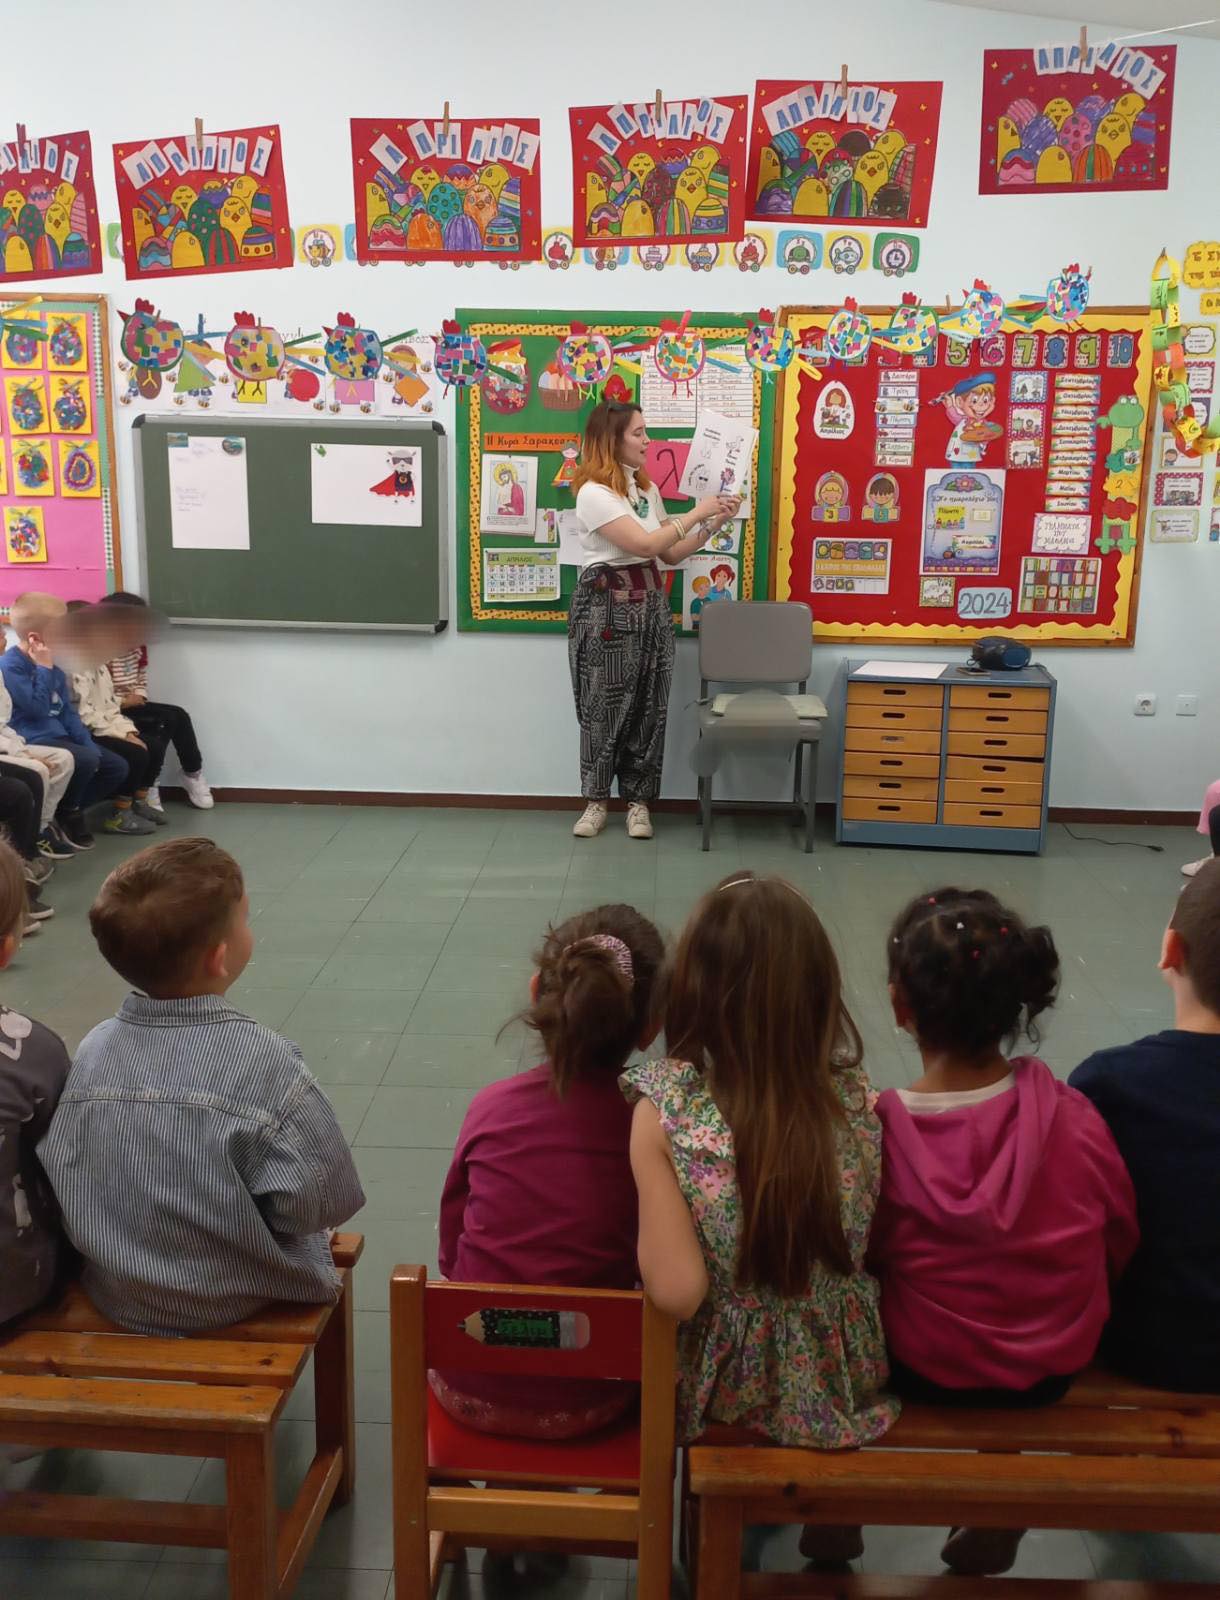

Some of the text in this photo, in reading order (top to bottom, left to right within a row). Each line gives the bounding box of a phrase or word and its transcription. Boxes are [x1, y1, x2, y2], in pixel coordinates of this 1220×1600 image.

[0, 144, 73, 178] ΙΛΙΟΣ
[136, 141, 264, 182] ΑΠΡΙΛΙΟΣ
[981, 337, 1002, 364] 6
[1015, 337, 1035, 365] 7
[1046, 337, 1067, 366] 8
[1078, 336, 1097, 365] 9
[1110, 335, 1133, 365] 10
[959, 591, 1009, 615] 2024
